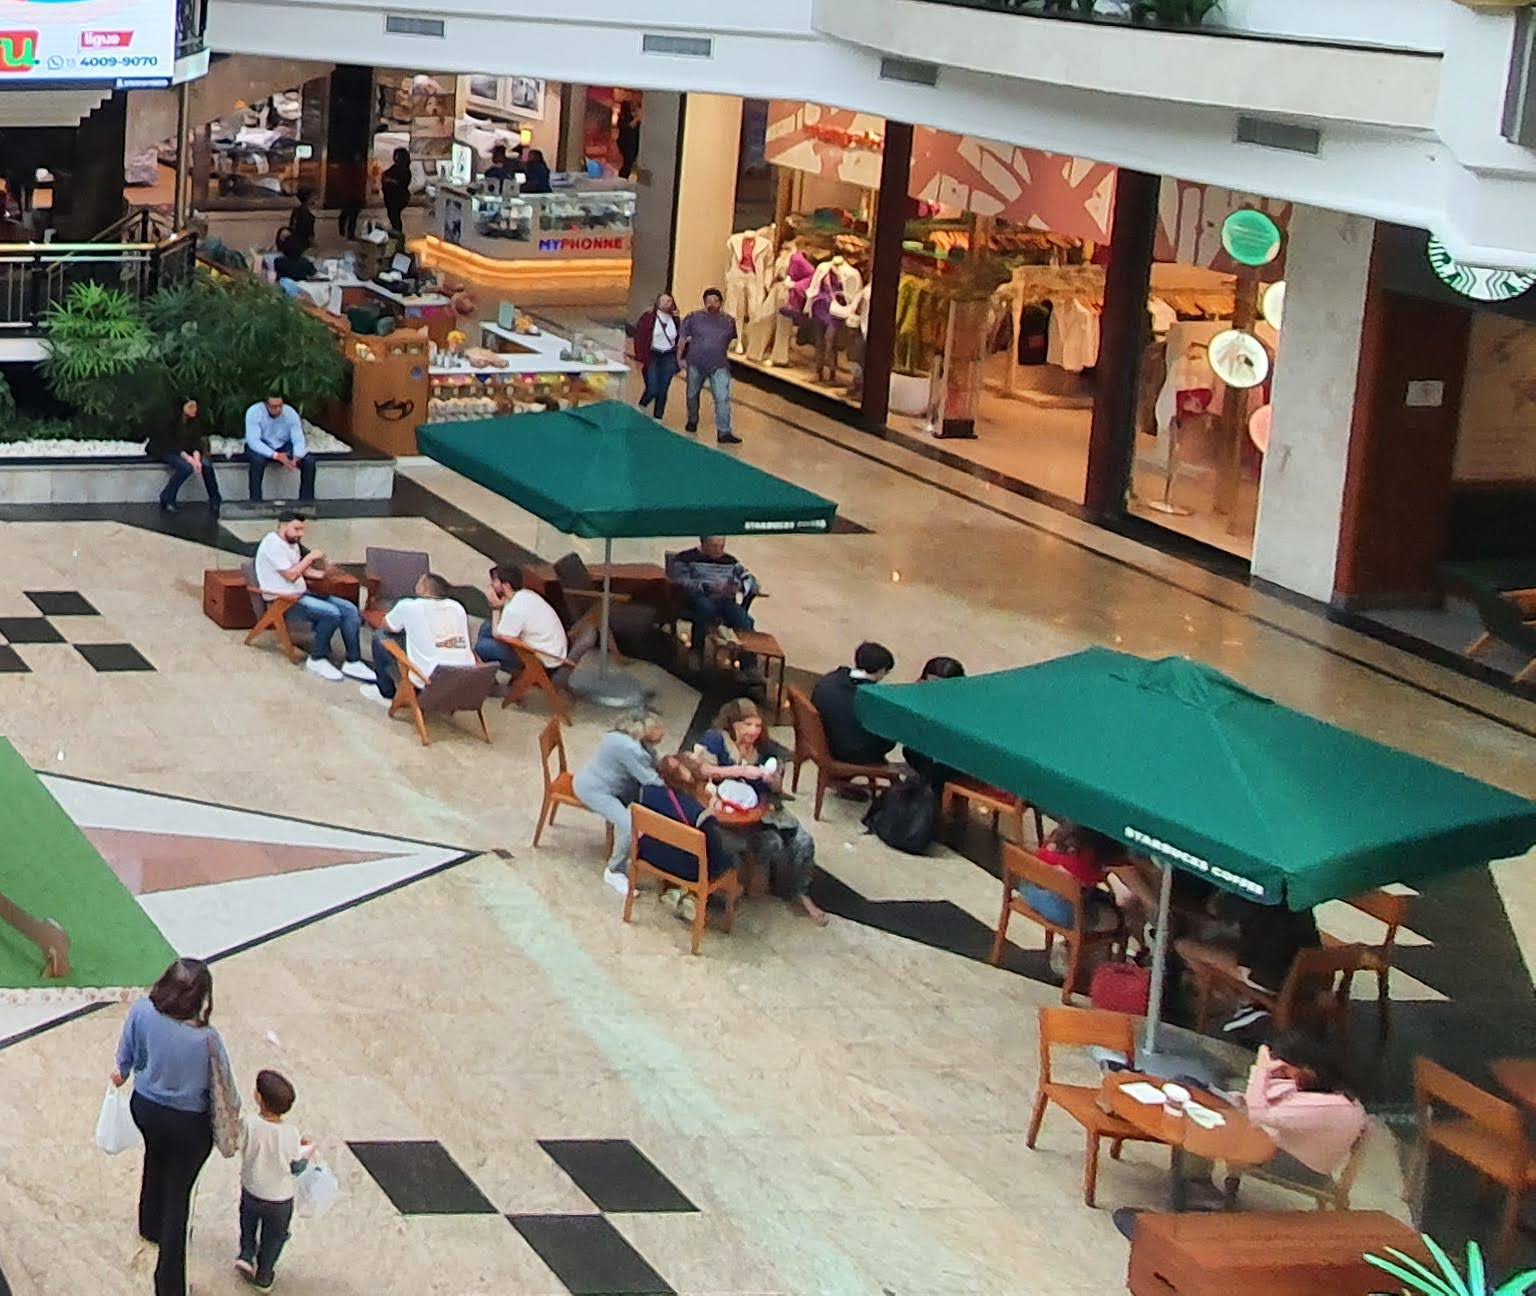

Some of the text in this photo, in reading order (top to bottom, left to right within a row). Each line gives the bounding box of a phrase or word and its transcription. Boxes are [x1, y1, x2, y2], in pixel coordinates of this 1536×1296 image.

[80, 56, 157, 67] 4009-9070
[539, 238, 622, 251] MYPHONNE
[1124, 826, 1208, 872] STARBUCKS
